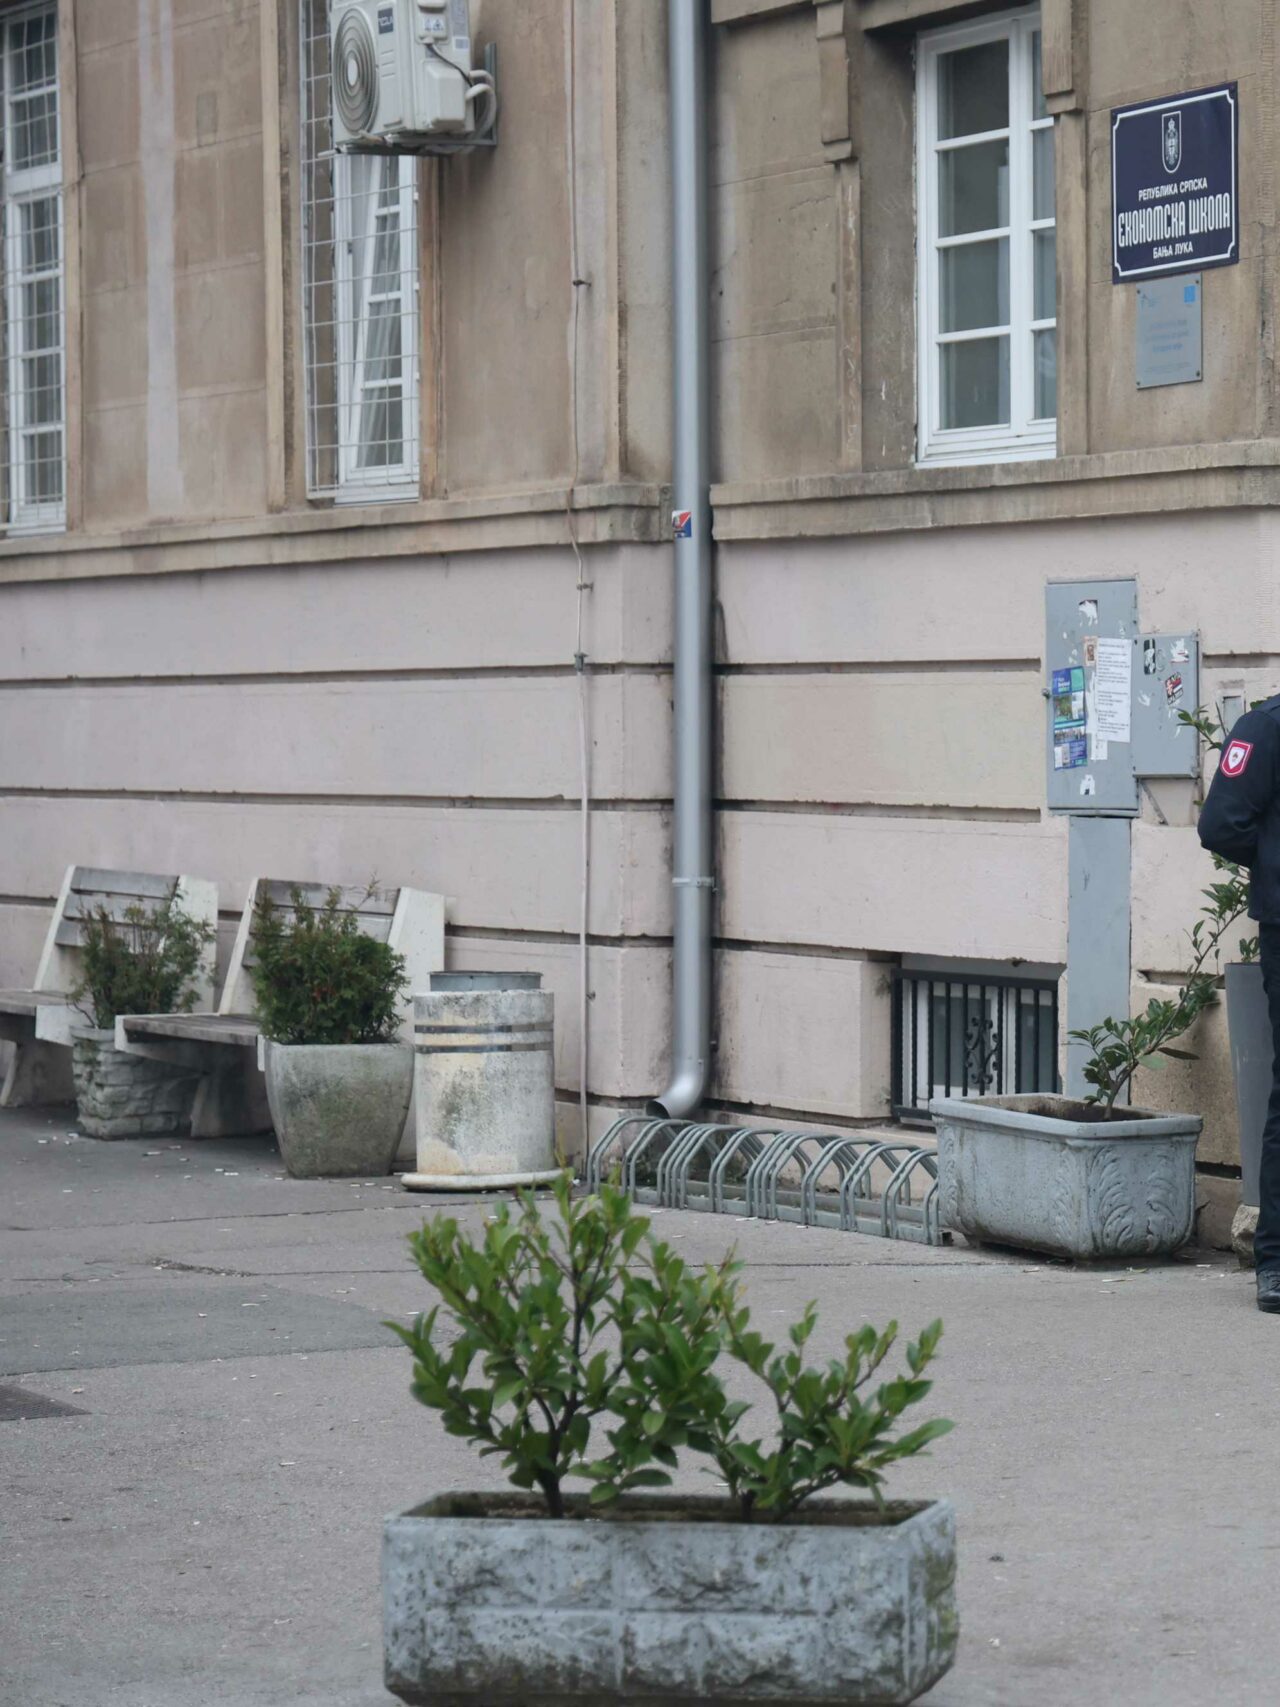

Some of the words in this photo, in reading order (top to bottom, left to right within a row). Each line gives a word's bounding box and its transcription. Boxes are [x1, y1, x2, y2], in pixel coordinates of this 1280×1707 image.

[1138, 183, 1178, 201] РЕПУБЛИКА
[1179, 177, 1207, 193] СРПСКА
[1118, 201, 1186, 247] ЕКОНОМСКА
[1188, 192, 1230, 233] ШКОЛА
[1152, 245, 1173, 259] БАЊА
[1174, 241, 1193, 255] ЛУКА
